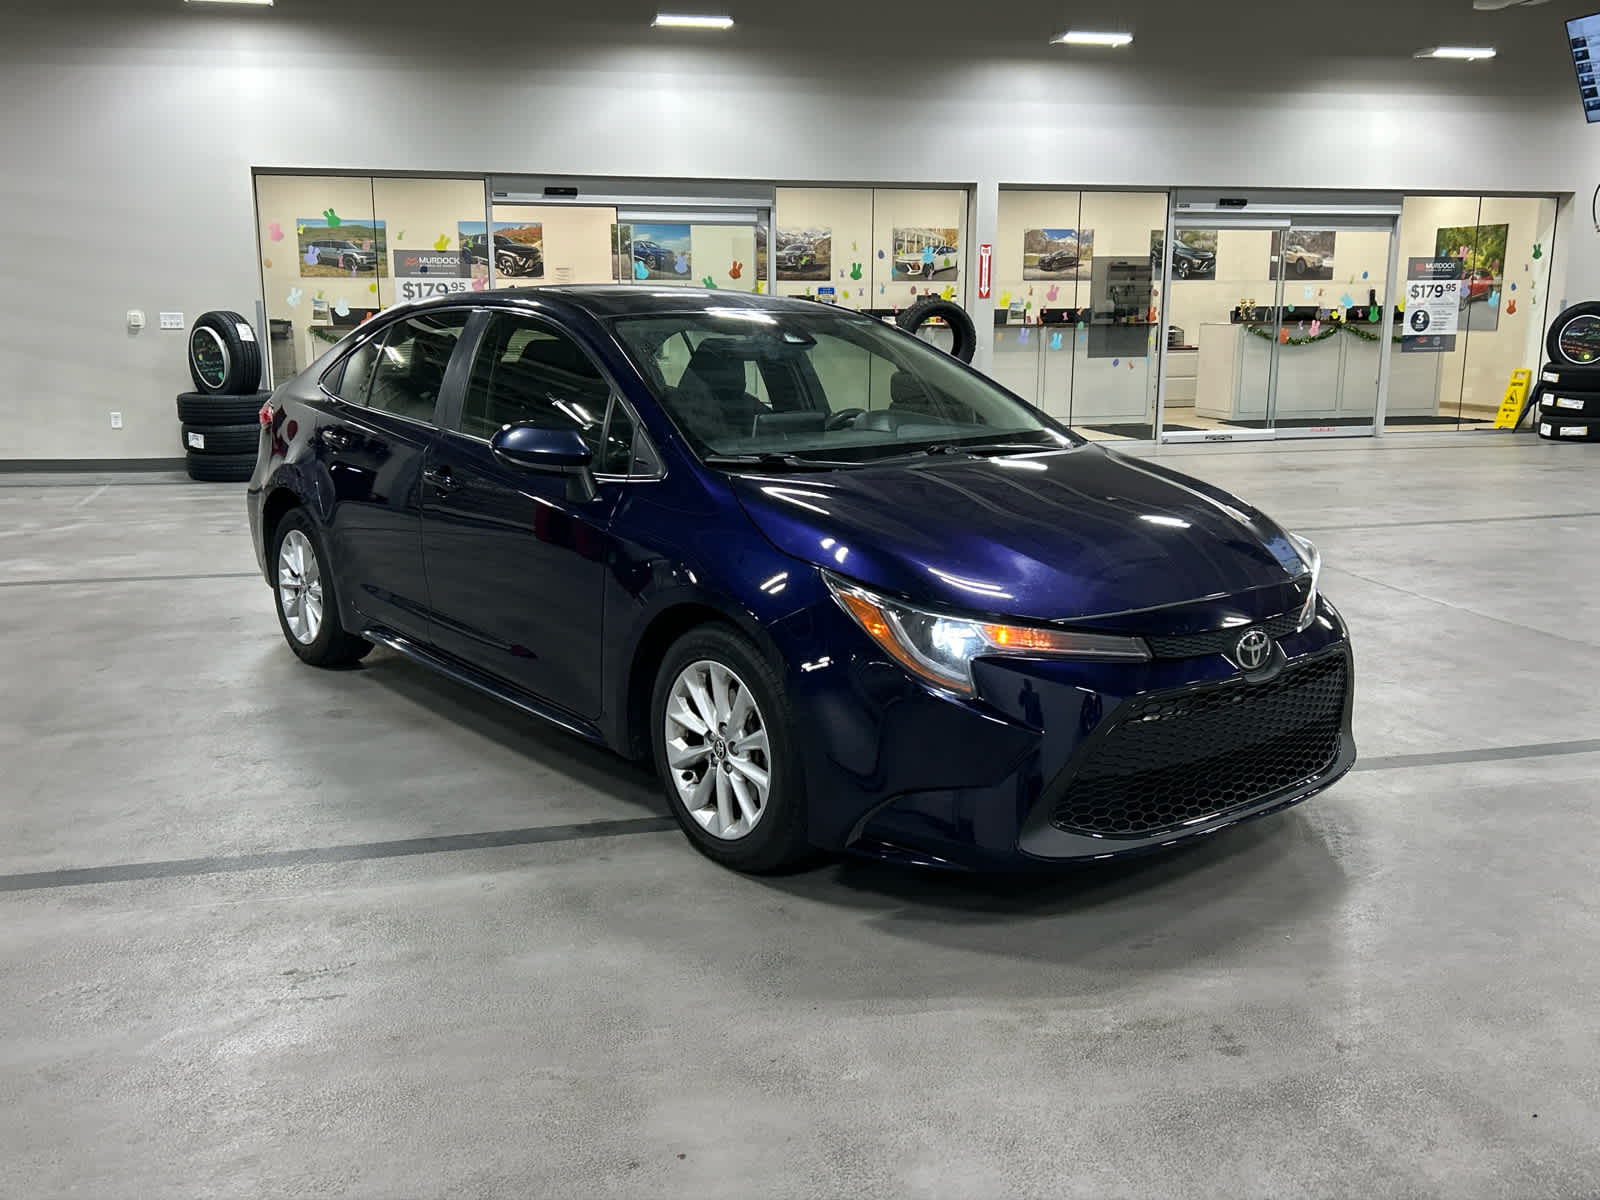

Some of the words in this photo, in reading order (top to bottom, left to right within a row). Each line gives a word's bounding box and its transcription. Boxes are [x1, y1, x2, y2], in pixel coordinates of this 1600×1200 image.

[419, 256, 461, 264] MURDOCK
[402, 281, 466, 300] $179.95
[1410, 283, 1457, 299] $179.95
[1416, 312, 1425, 323] 3
